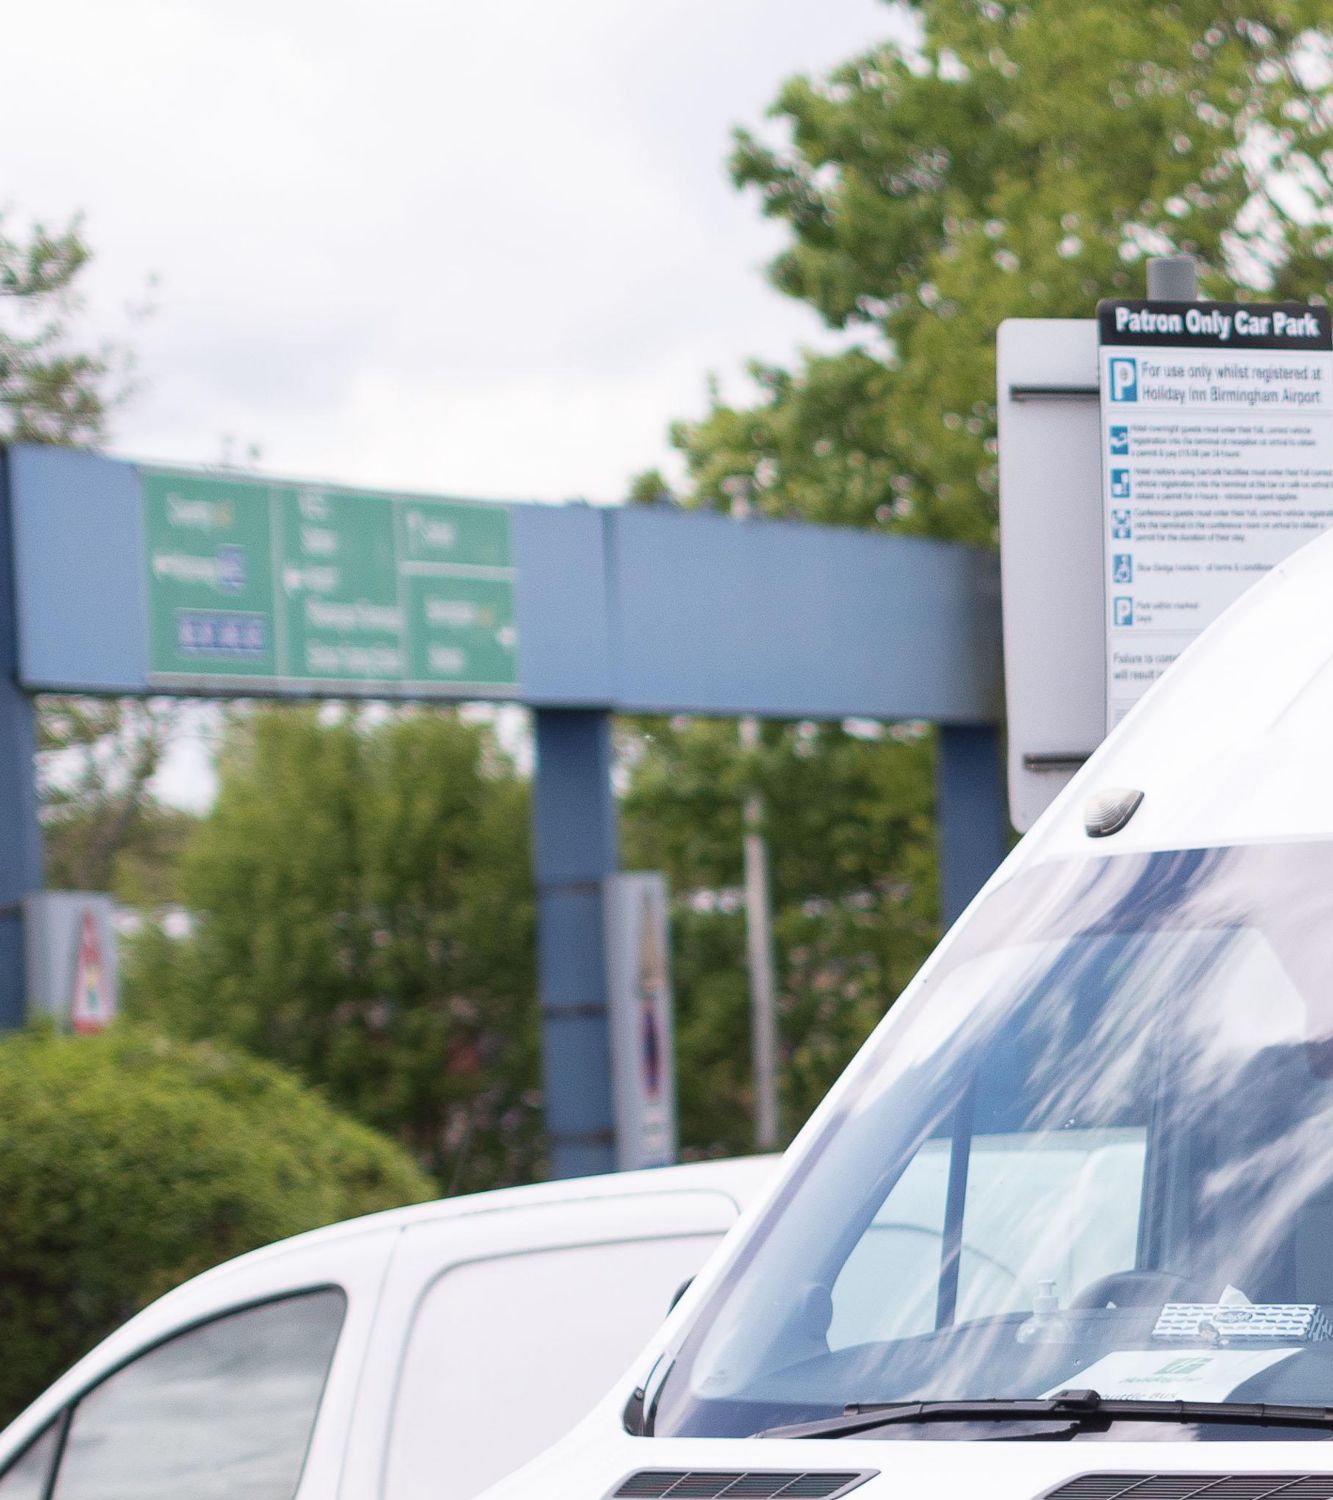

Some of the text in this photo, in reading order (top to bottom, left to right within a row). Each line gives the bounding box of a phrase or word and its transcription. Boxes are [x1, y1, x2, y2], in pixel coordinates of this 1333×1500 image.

[1115, 306, 1321, 341] Patron Only Car Park
[1141, 362, 1160, 377] For
[1164, 366, 1184, 378] use
[1188, 363, 1212, 381] only
[1216, 364, 1248, 379] whilst
[1252, 365, 1308, 383] registered
[1142, 386, 1321, 405] Holiday Inn Birmingham Airport
